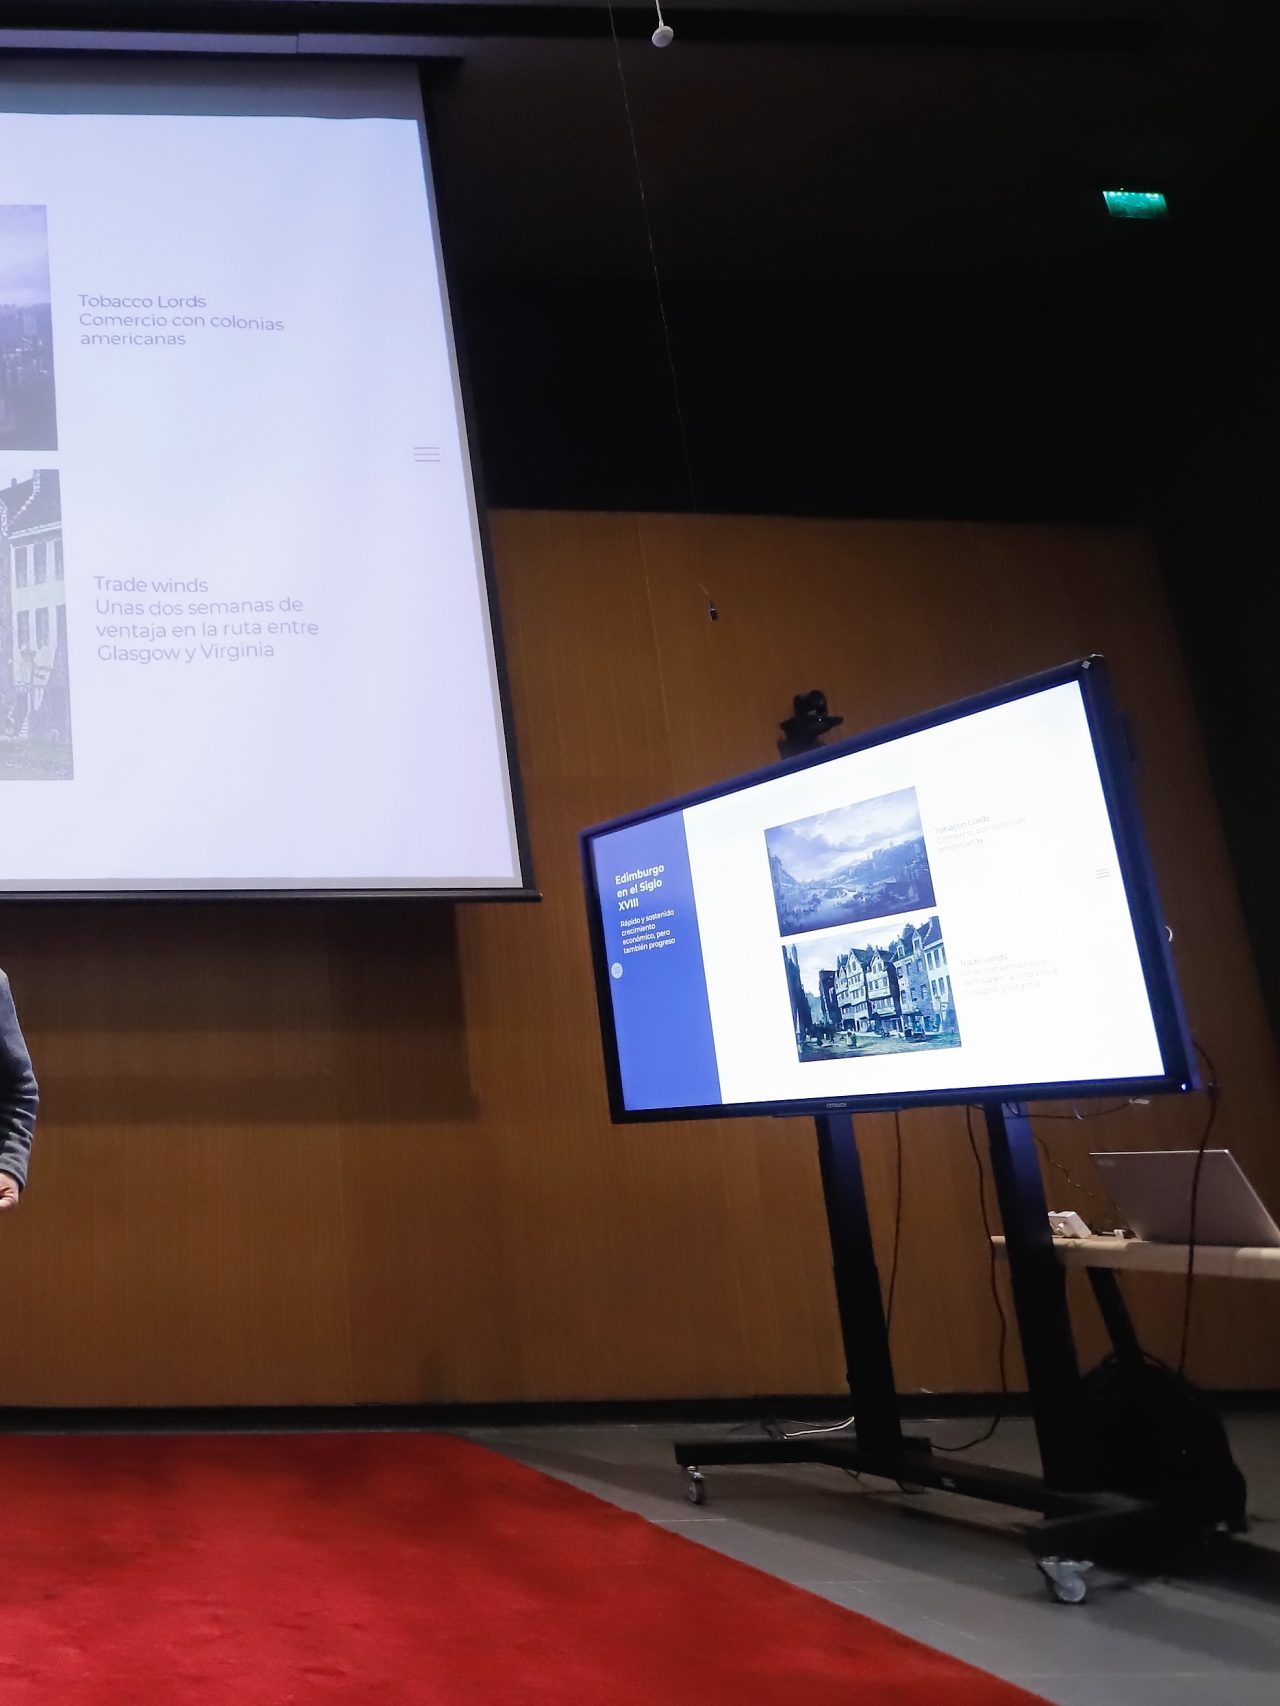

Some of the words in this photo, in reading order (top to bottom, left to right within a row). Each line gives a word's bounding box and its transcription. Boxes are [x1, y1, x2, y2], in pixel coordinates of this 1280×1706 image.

[78, 293, 153, 308] Tobacco
[157, 295, 207, 308] Lords
[79, 312, 168, 327] Comercio
[171, 315, 205, 327] con
[209, 314, 285, 332] colonias
[80, 332, 187, 346] americanas
[93, 575, 148, 593] Trade
[151, 577, 209, 593] winds
[95, 598, 145, 616] Unas
[149, 600, 184, 616] dos
[187, 599, 274, 615] semanas
[279, 597, 303, 612] de
[95, 622, 167, 642] ventaja
[171, 624, 196, 639] en
[202, 621, 217, 637] la
[223, 620, 262, 636] ruta
[267, 620, 319, 636] entre
[97, 644, 181, 664] Glasgow
[184, 647, 197, 663] y
[200, 641, 275, 662] Virginia
[615, 864, 665, 885] Edimburgo
[616, 888, 628, 898] en
[629, 884, 638, 895] el
[639, 878, 663, 892] Siglo
[618, 897, 639, 912] XVIII
[645, 908, 675, 922] sostenido
[621, 923, 656, 937] crecimiento
[656, 929, 671, 940] pero
[623, 942, 648, 955] también
[649, 937, 676, 951] progreso
